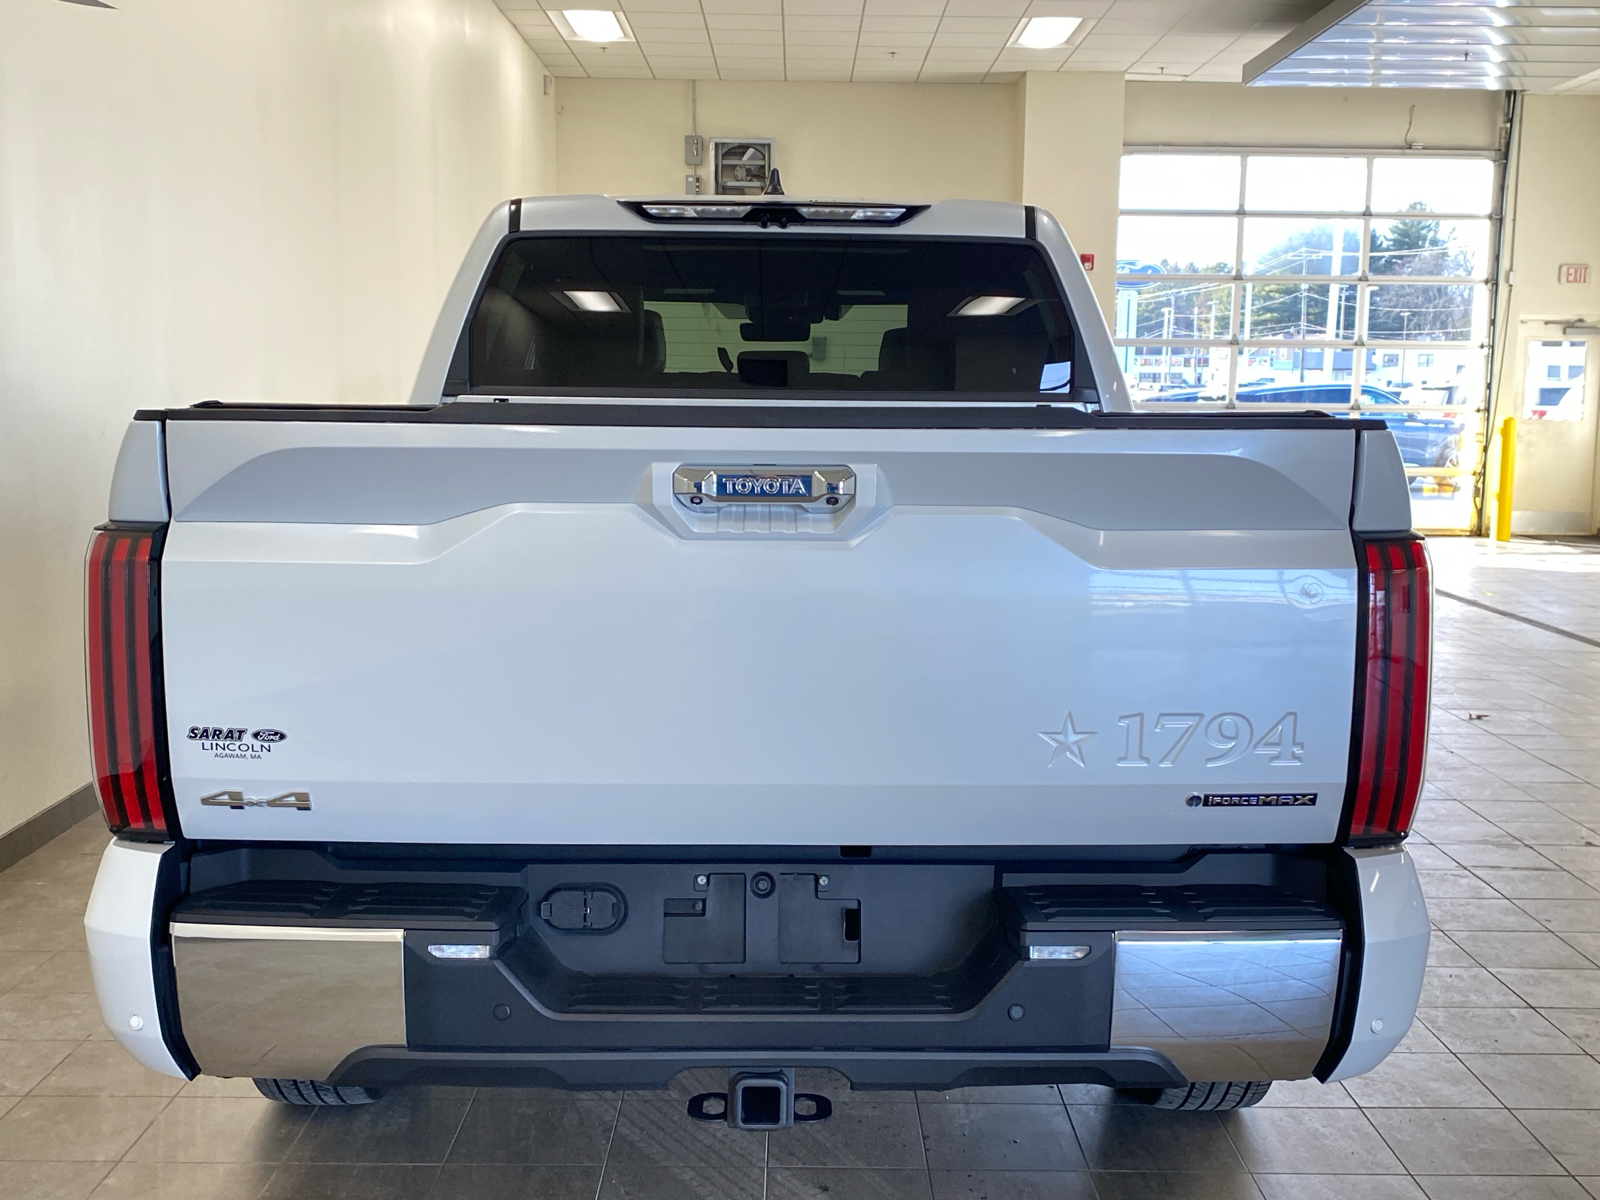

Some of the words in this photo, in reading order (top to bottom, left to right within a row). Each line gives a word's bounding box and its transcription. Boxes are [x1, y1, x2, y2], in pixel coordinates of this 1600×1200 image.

[1566, 266, 1588, 283] EXIT
[722, 477, 808, 495] TOYOTA
[187, 726, 248, 741] SARAT
[1116, 711, 1305, 767] 1794
[201, 742, 271, 752] LINCOLN
[214, 752, 249, 760] AGAWAM,
